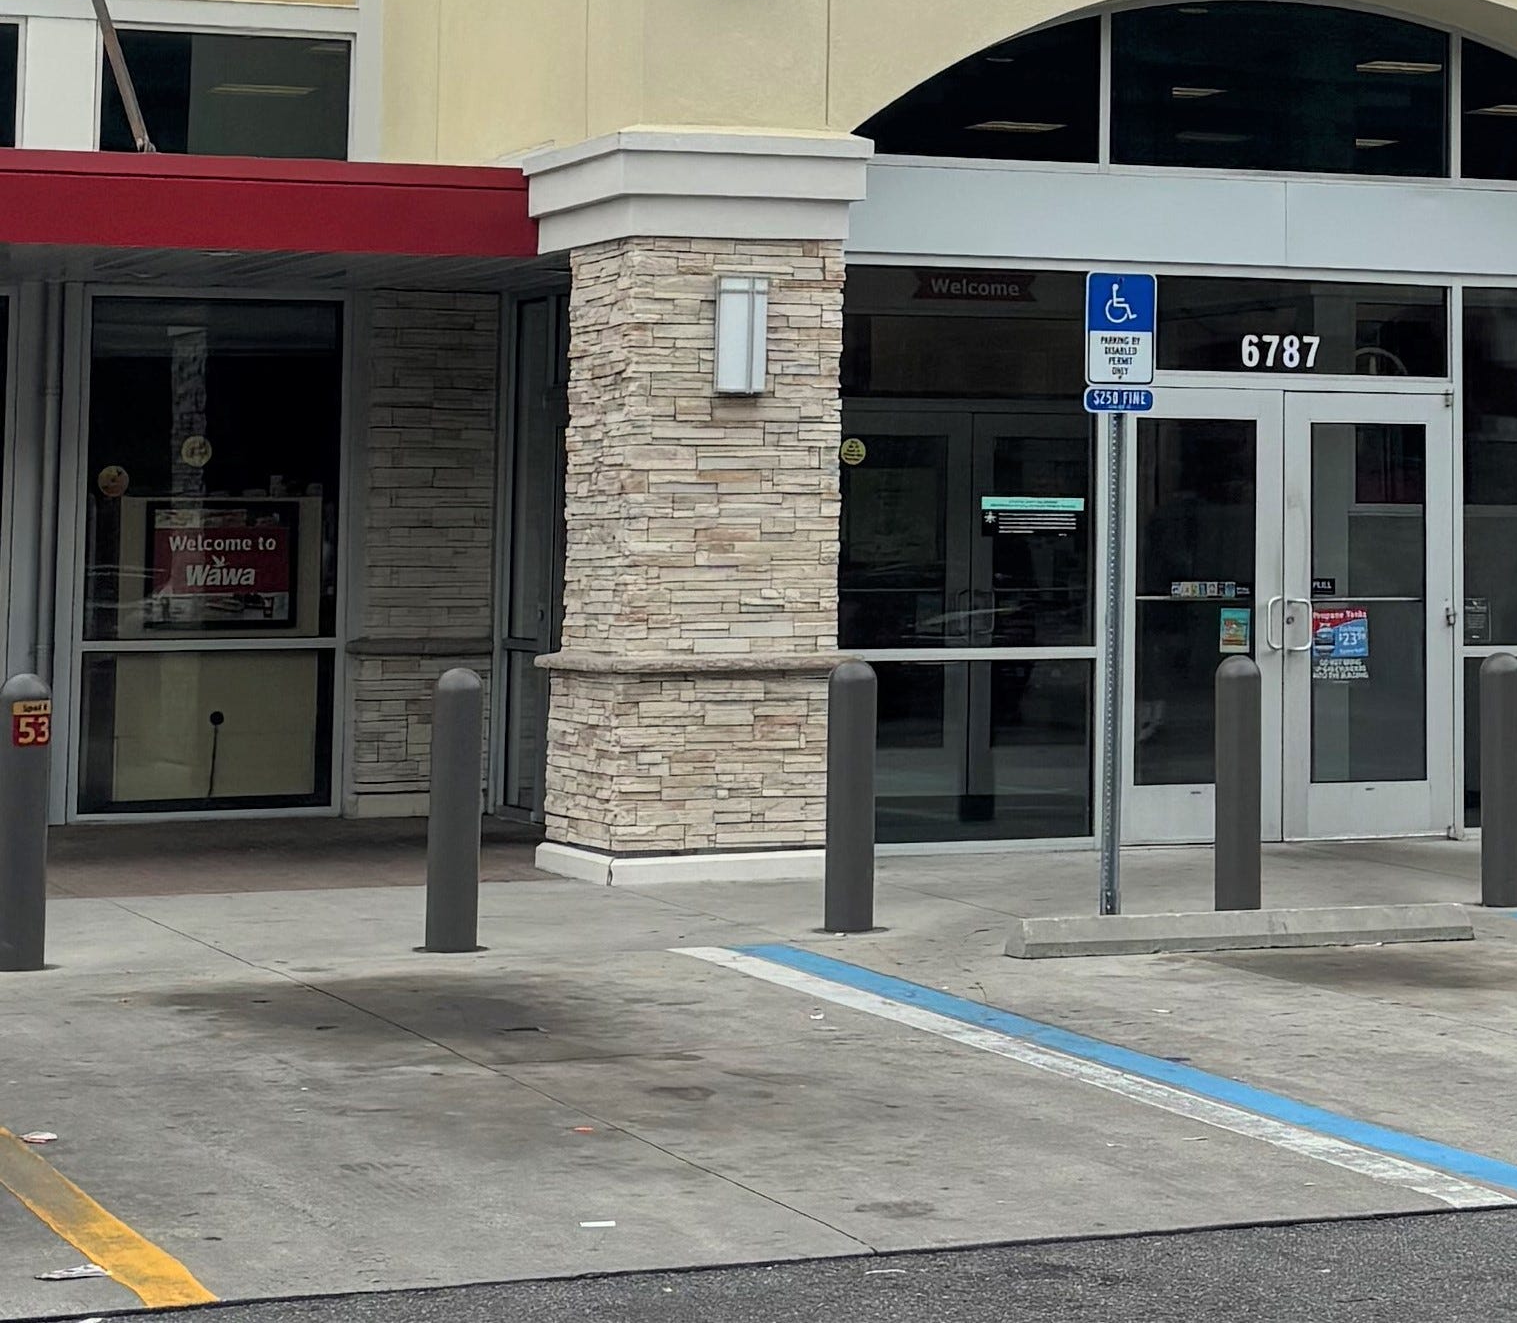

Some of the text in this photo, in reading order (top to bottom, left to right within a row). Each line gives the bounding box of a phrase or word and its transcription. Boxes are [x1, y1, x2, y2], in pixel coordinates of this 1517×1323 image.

[930, 278, 1020, 296] Welcome
[1241, 334, 1320, 368] 6787
[1093, 390, 1147, 406] $250 FINE
[169, 534, 277, 552] Welcome to
[186, 565, 255, 586] Wawa
[19, 717, 49, 743] 53
